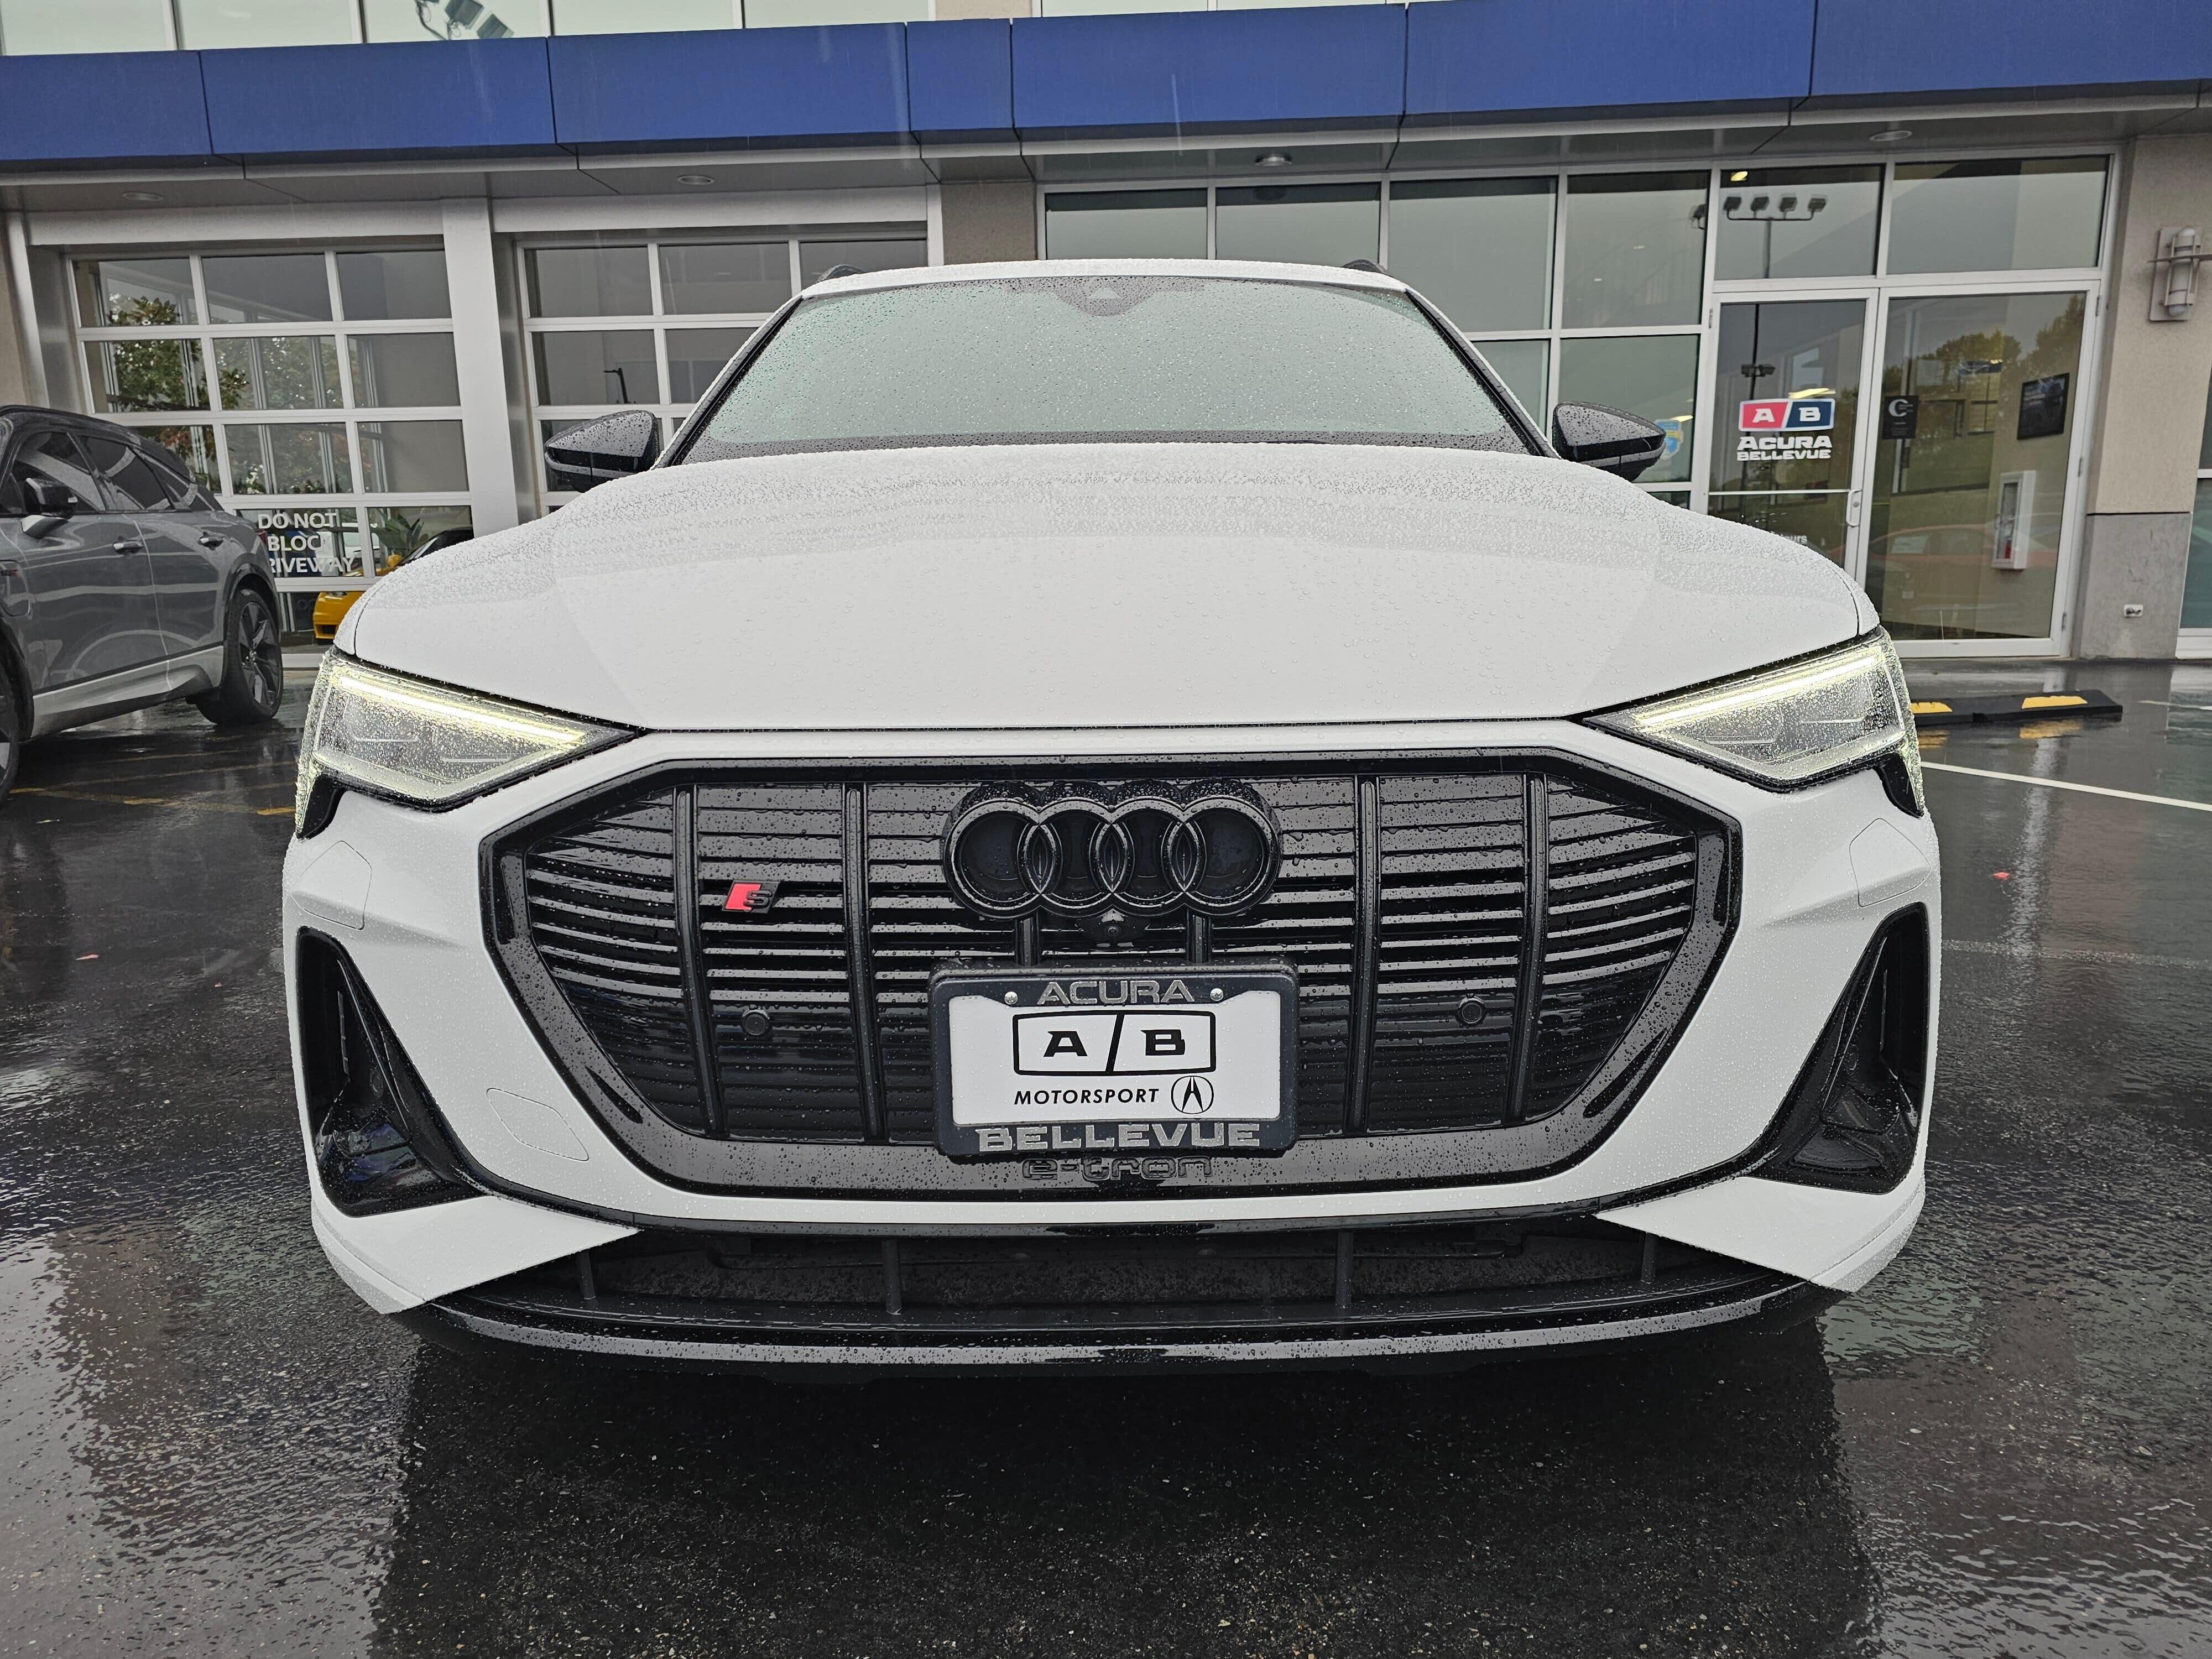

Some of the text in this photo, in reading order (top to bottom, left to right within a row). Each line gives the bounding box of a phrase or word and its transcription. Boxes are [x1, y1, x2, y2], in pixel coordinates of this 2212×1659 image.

[1752, 407, 1821, 423] A B
[1737, 435, 1833, 451] ACURA
[1736, 449, 1832, 461] BELLEVUE
[258, 512, 337, 529] DO NOT
[269, 557, 355, 573] RIVEWAY
[1036, 979, 1195, 1005] ACURA
[1043, 1029, 1186, 1057] A B
[1014, 1088, 1160, 1105] MOTORSPORT
[975, 1123, 1260, 1152] BELLEVUE
[1021, 1156, 1212, 1181] e-tron
